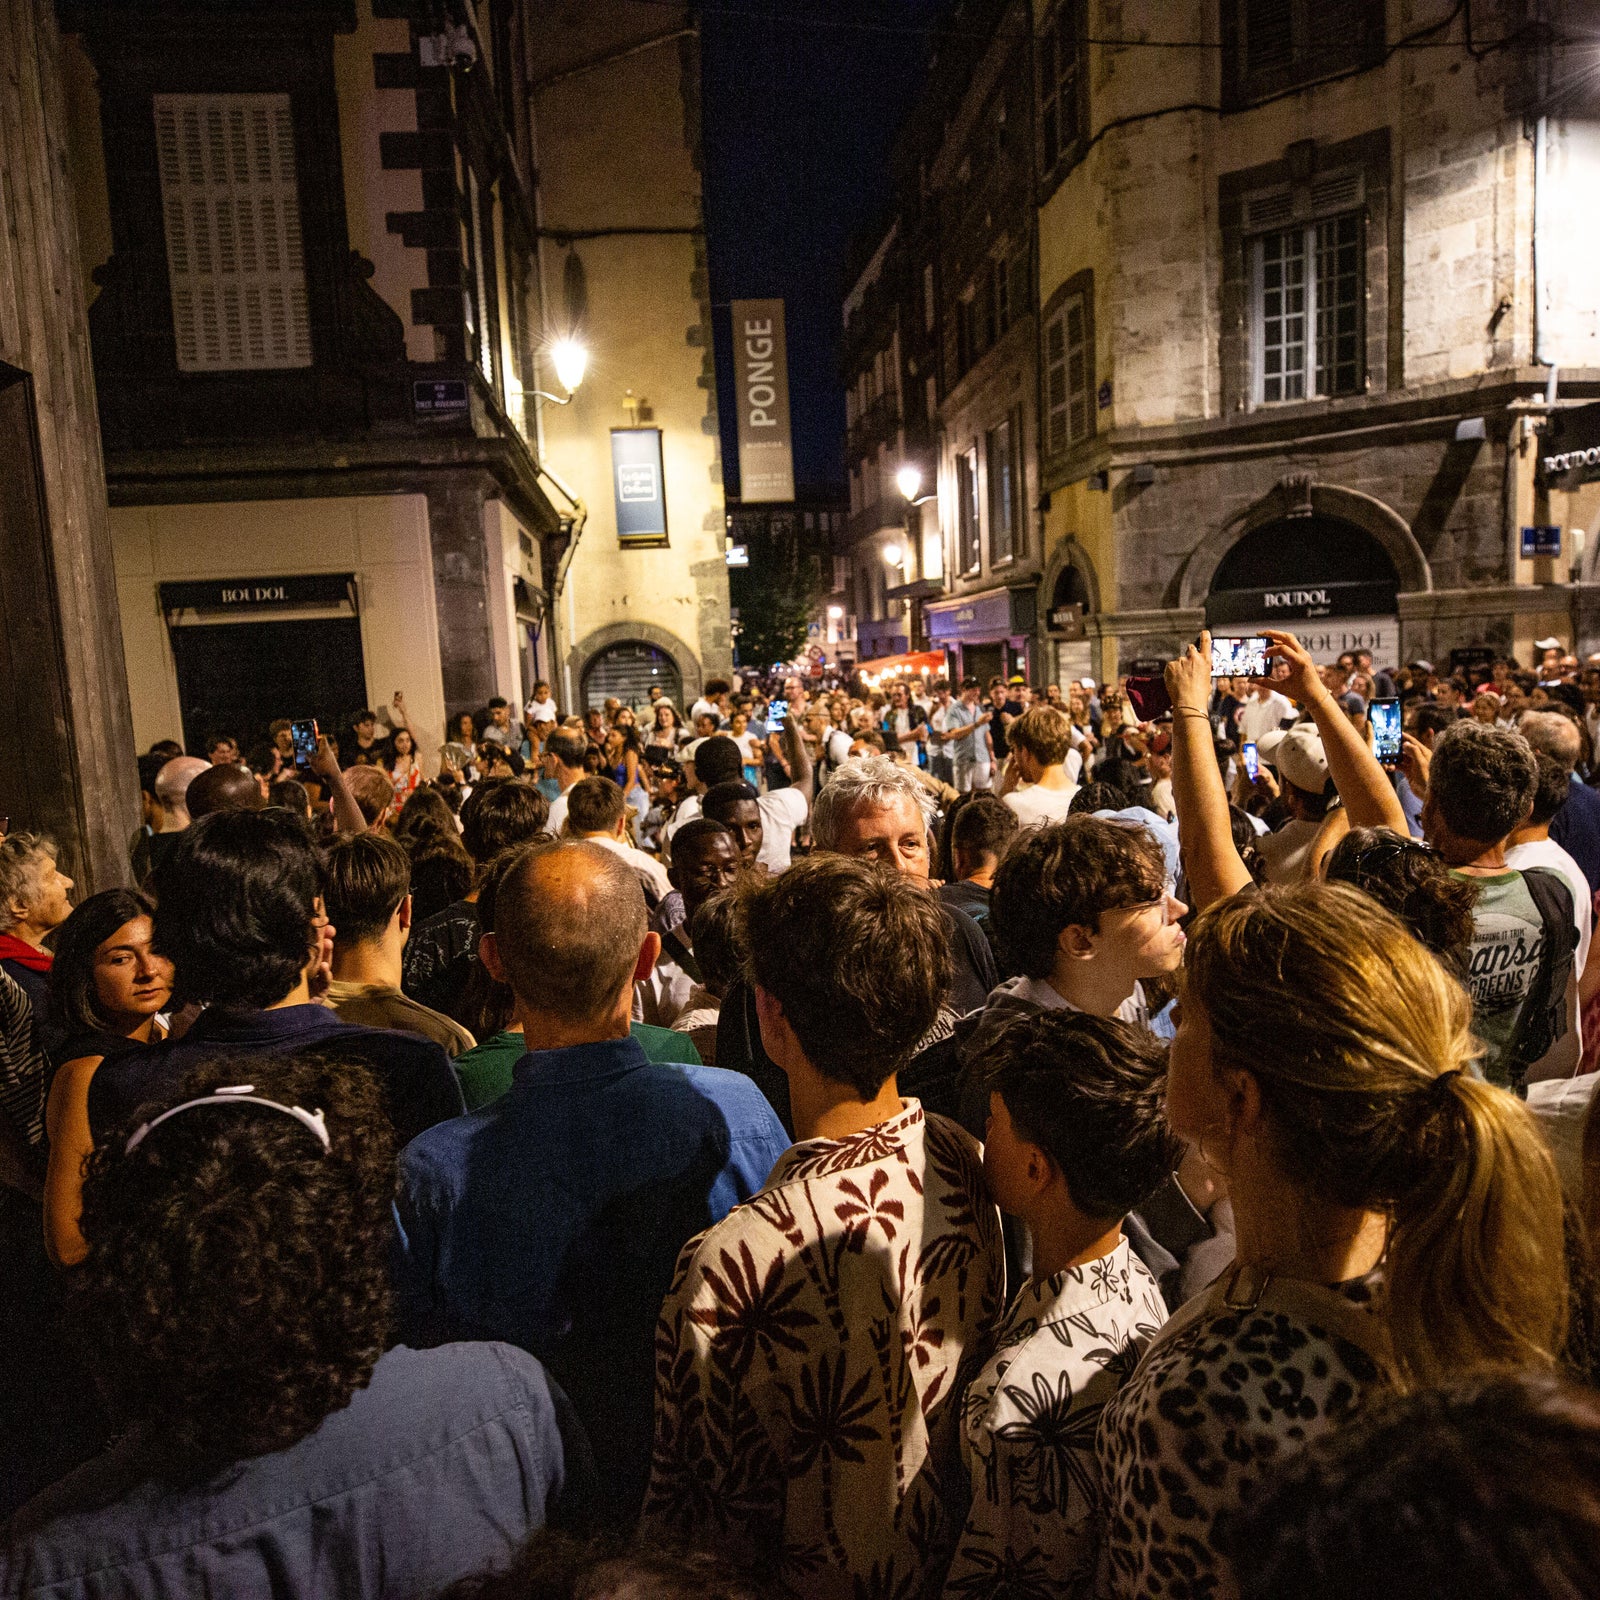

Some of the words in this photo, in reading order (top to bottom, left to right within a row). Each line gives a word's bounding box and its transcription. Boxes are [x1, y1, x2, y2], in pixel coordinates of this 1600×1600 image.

[745, 319, 777, 427] PONGE
[1543, 447, 1600, 473] BOUDO
[1264, 589, 1331, 608] BOUDOL
[1469, 968, 1525, 1000] GREENS
